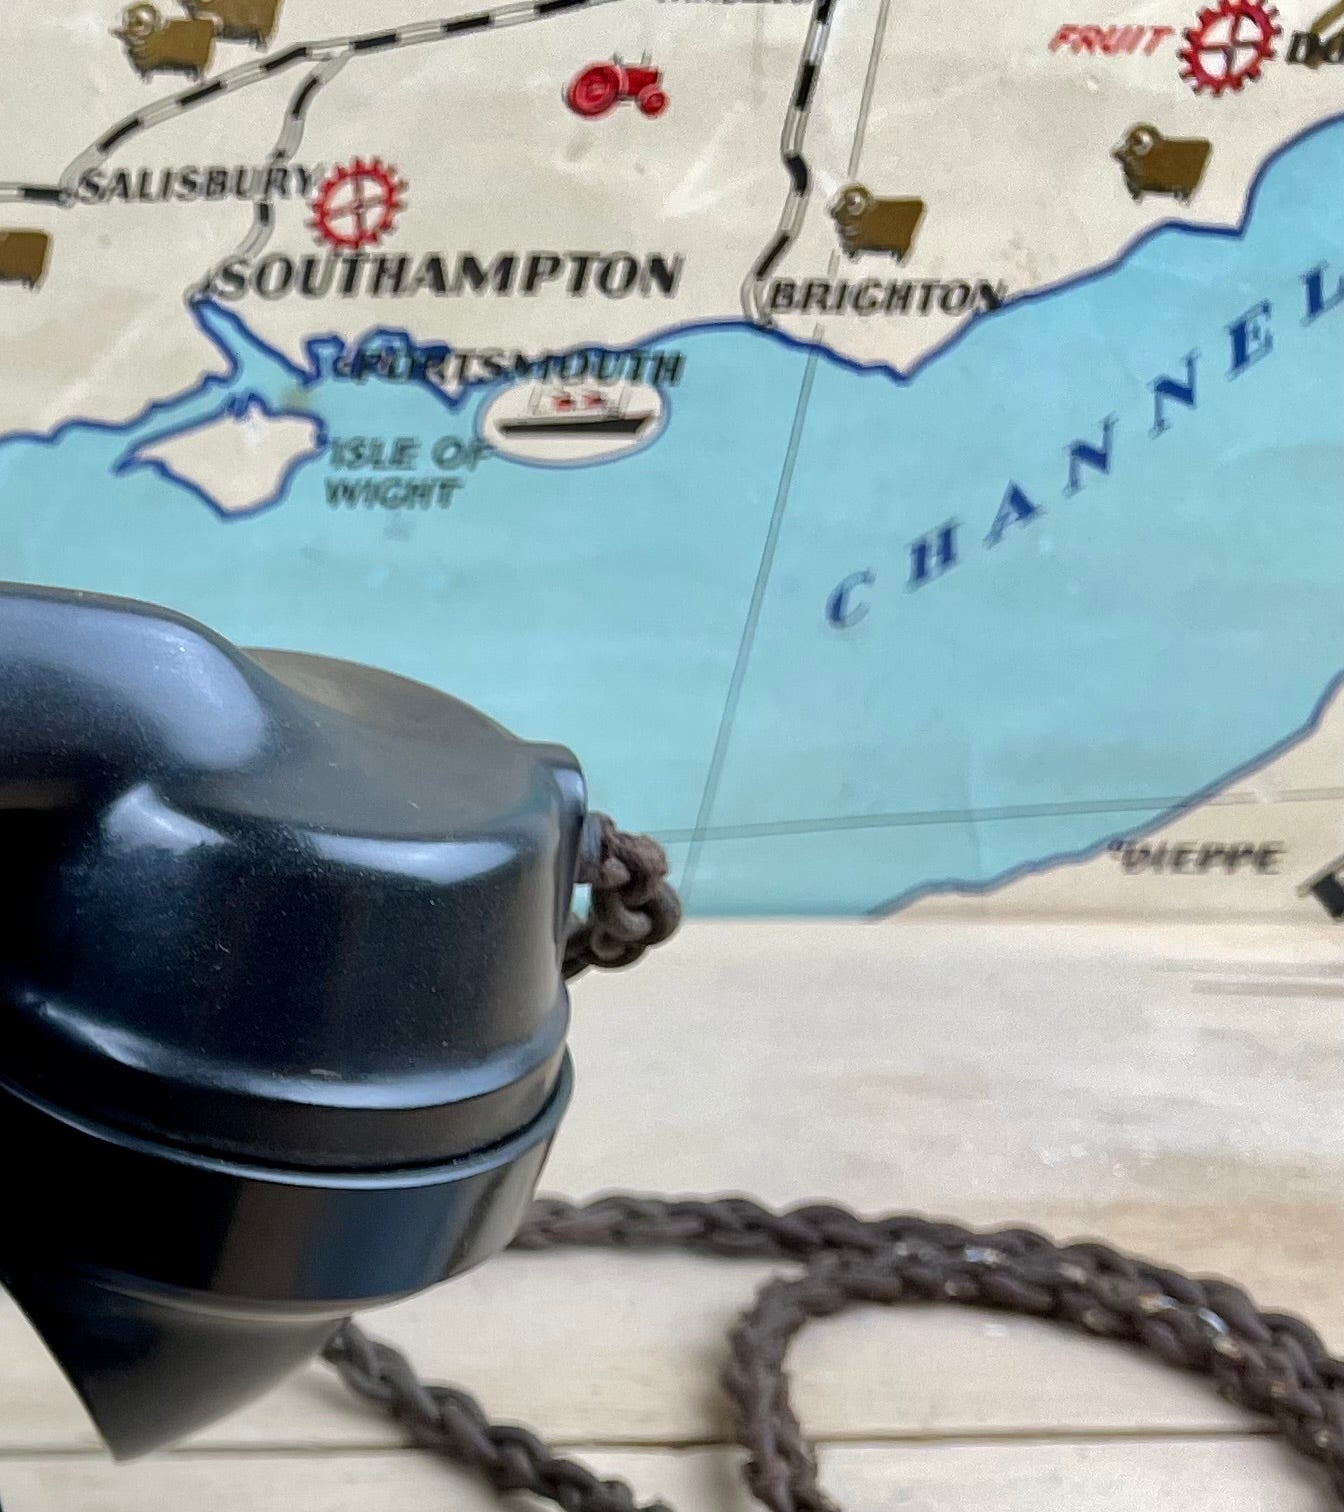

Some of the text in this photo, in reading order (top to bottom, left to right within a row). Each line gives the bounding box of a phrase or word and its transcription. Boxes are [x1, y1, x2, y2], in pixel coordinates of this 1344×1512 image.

[76, 166, 317, 204] SALISBURY
[215, 252, 684, 299] SOUTHAMPTON
[769, 277, 1010, 318] BRIGHTON
[330, 436, 497, 473] ISLE OF
[824, 260, 1344, 632] CHANNEL
[324, 477, 464, 511] WIGHT
[1120, 840, 1286, 876] DIEPPE
